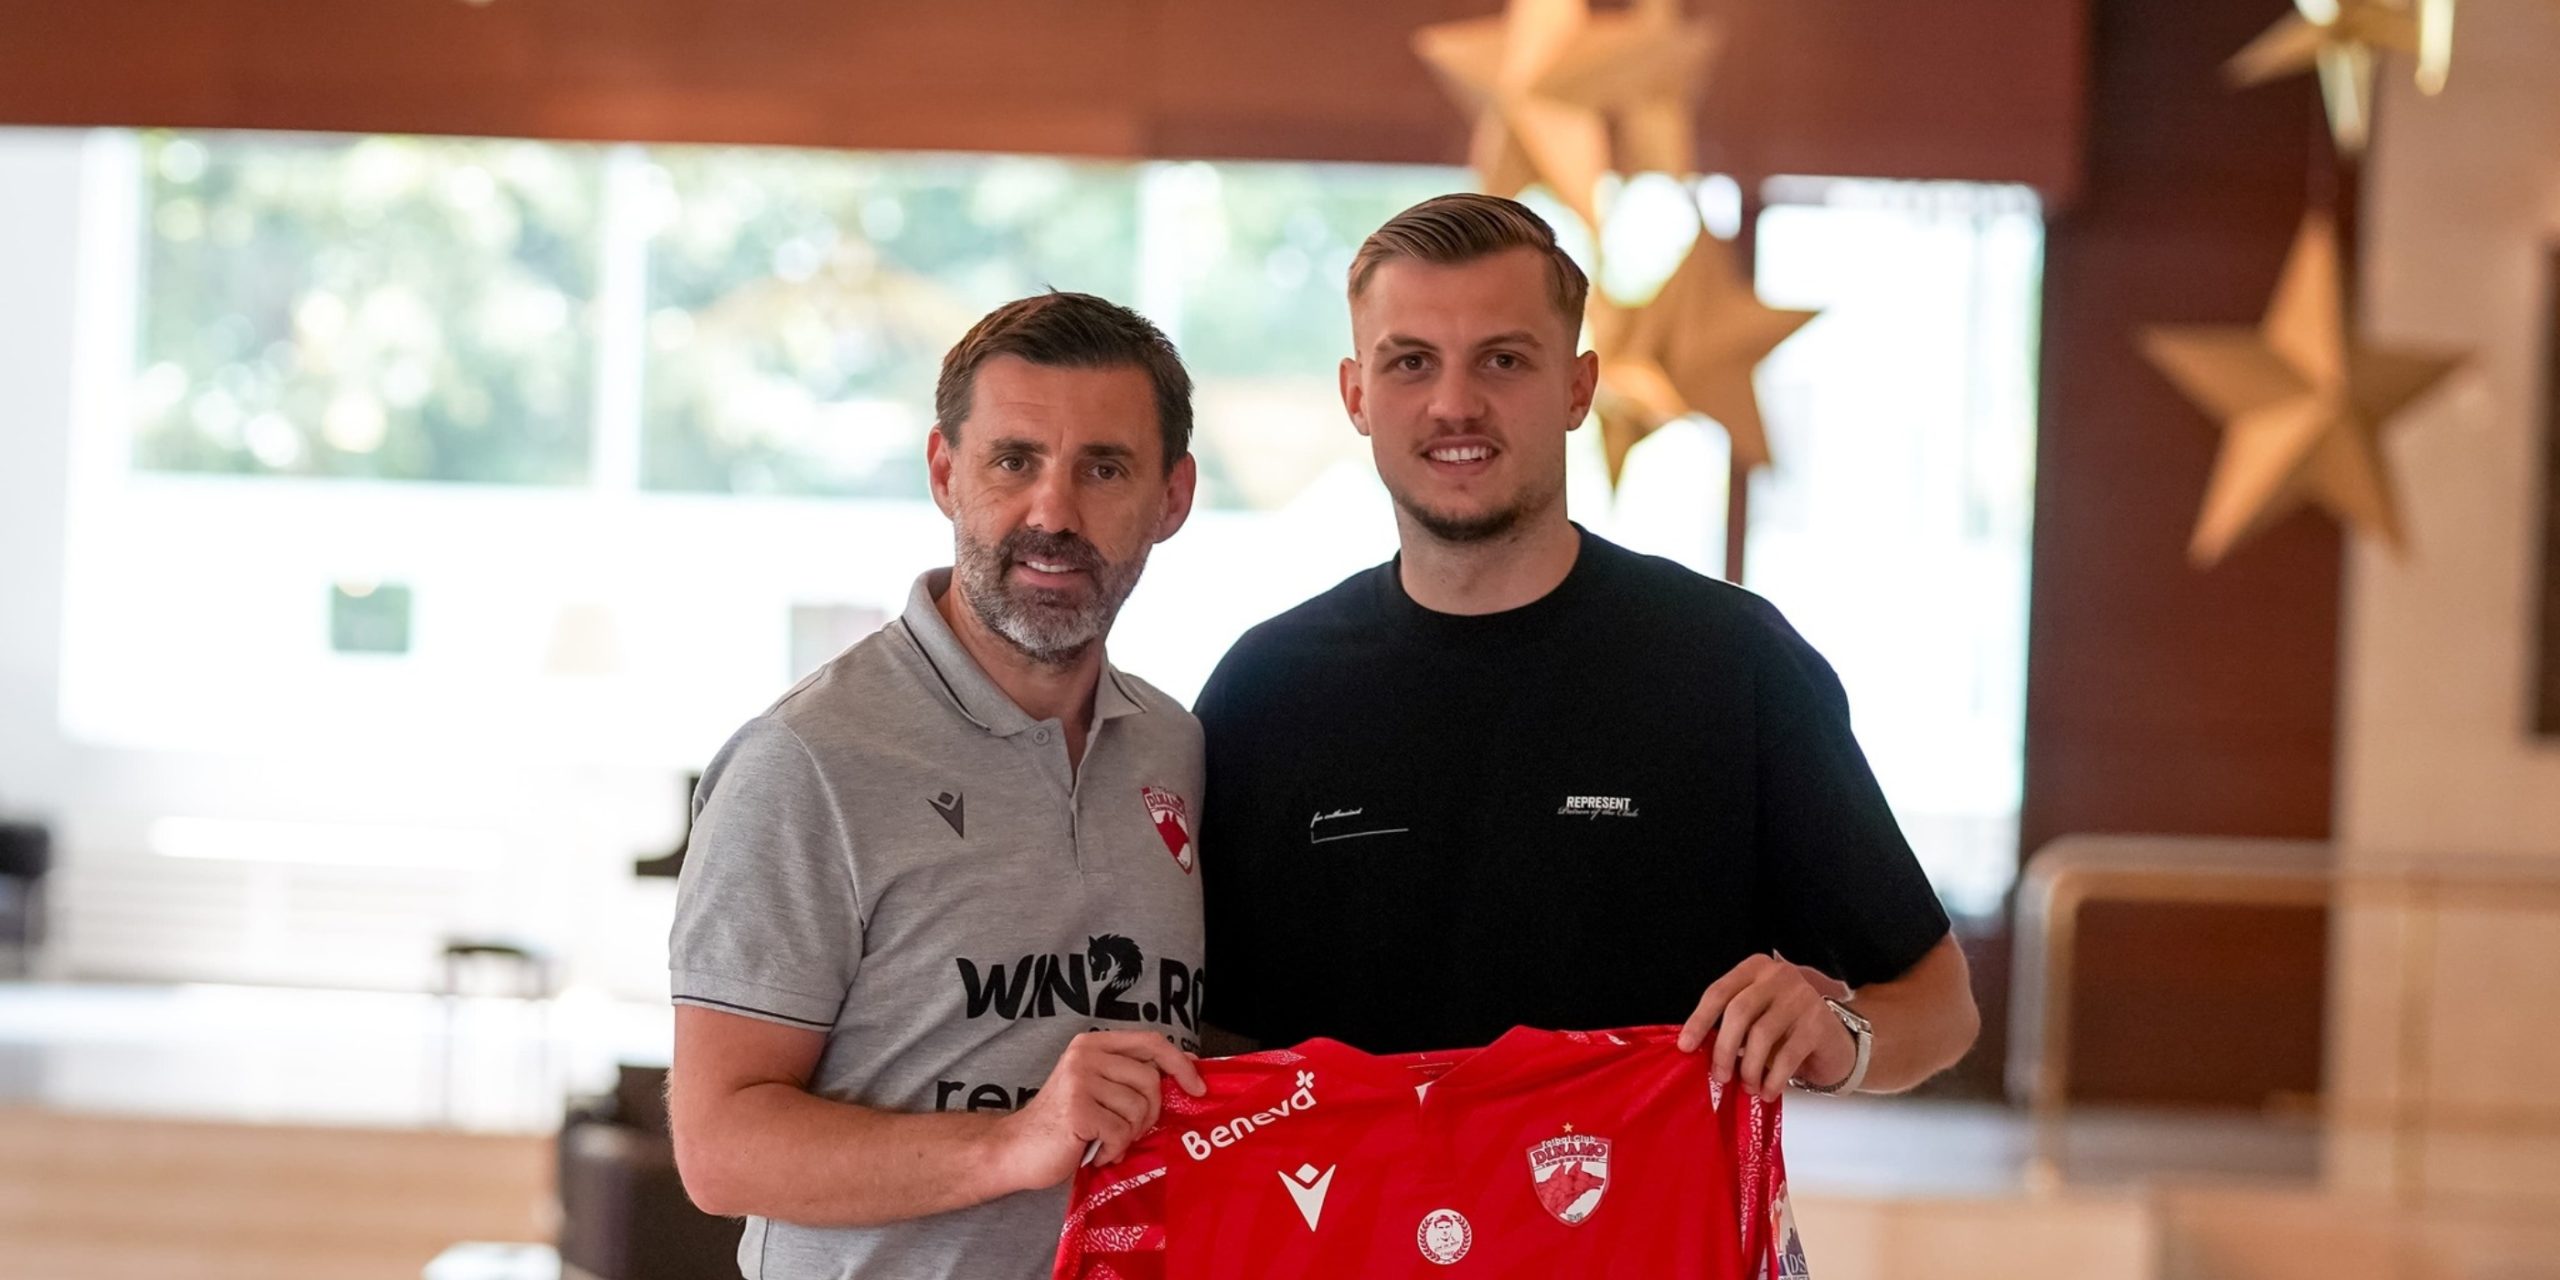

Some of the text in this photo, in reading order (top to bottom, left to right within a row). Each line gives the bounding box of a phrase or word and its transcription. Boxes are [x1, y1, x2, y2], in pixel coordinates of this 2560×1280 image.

[1566, 796, 1631, 811] REPRESENT
[1181, 1086, 1317, 1161] Beneva
[1532, 1143, 1607, 1165] DINAMO
